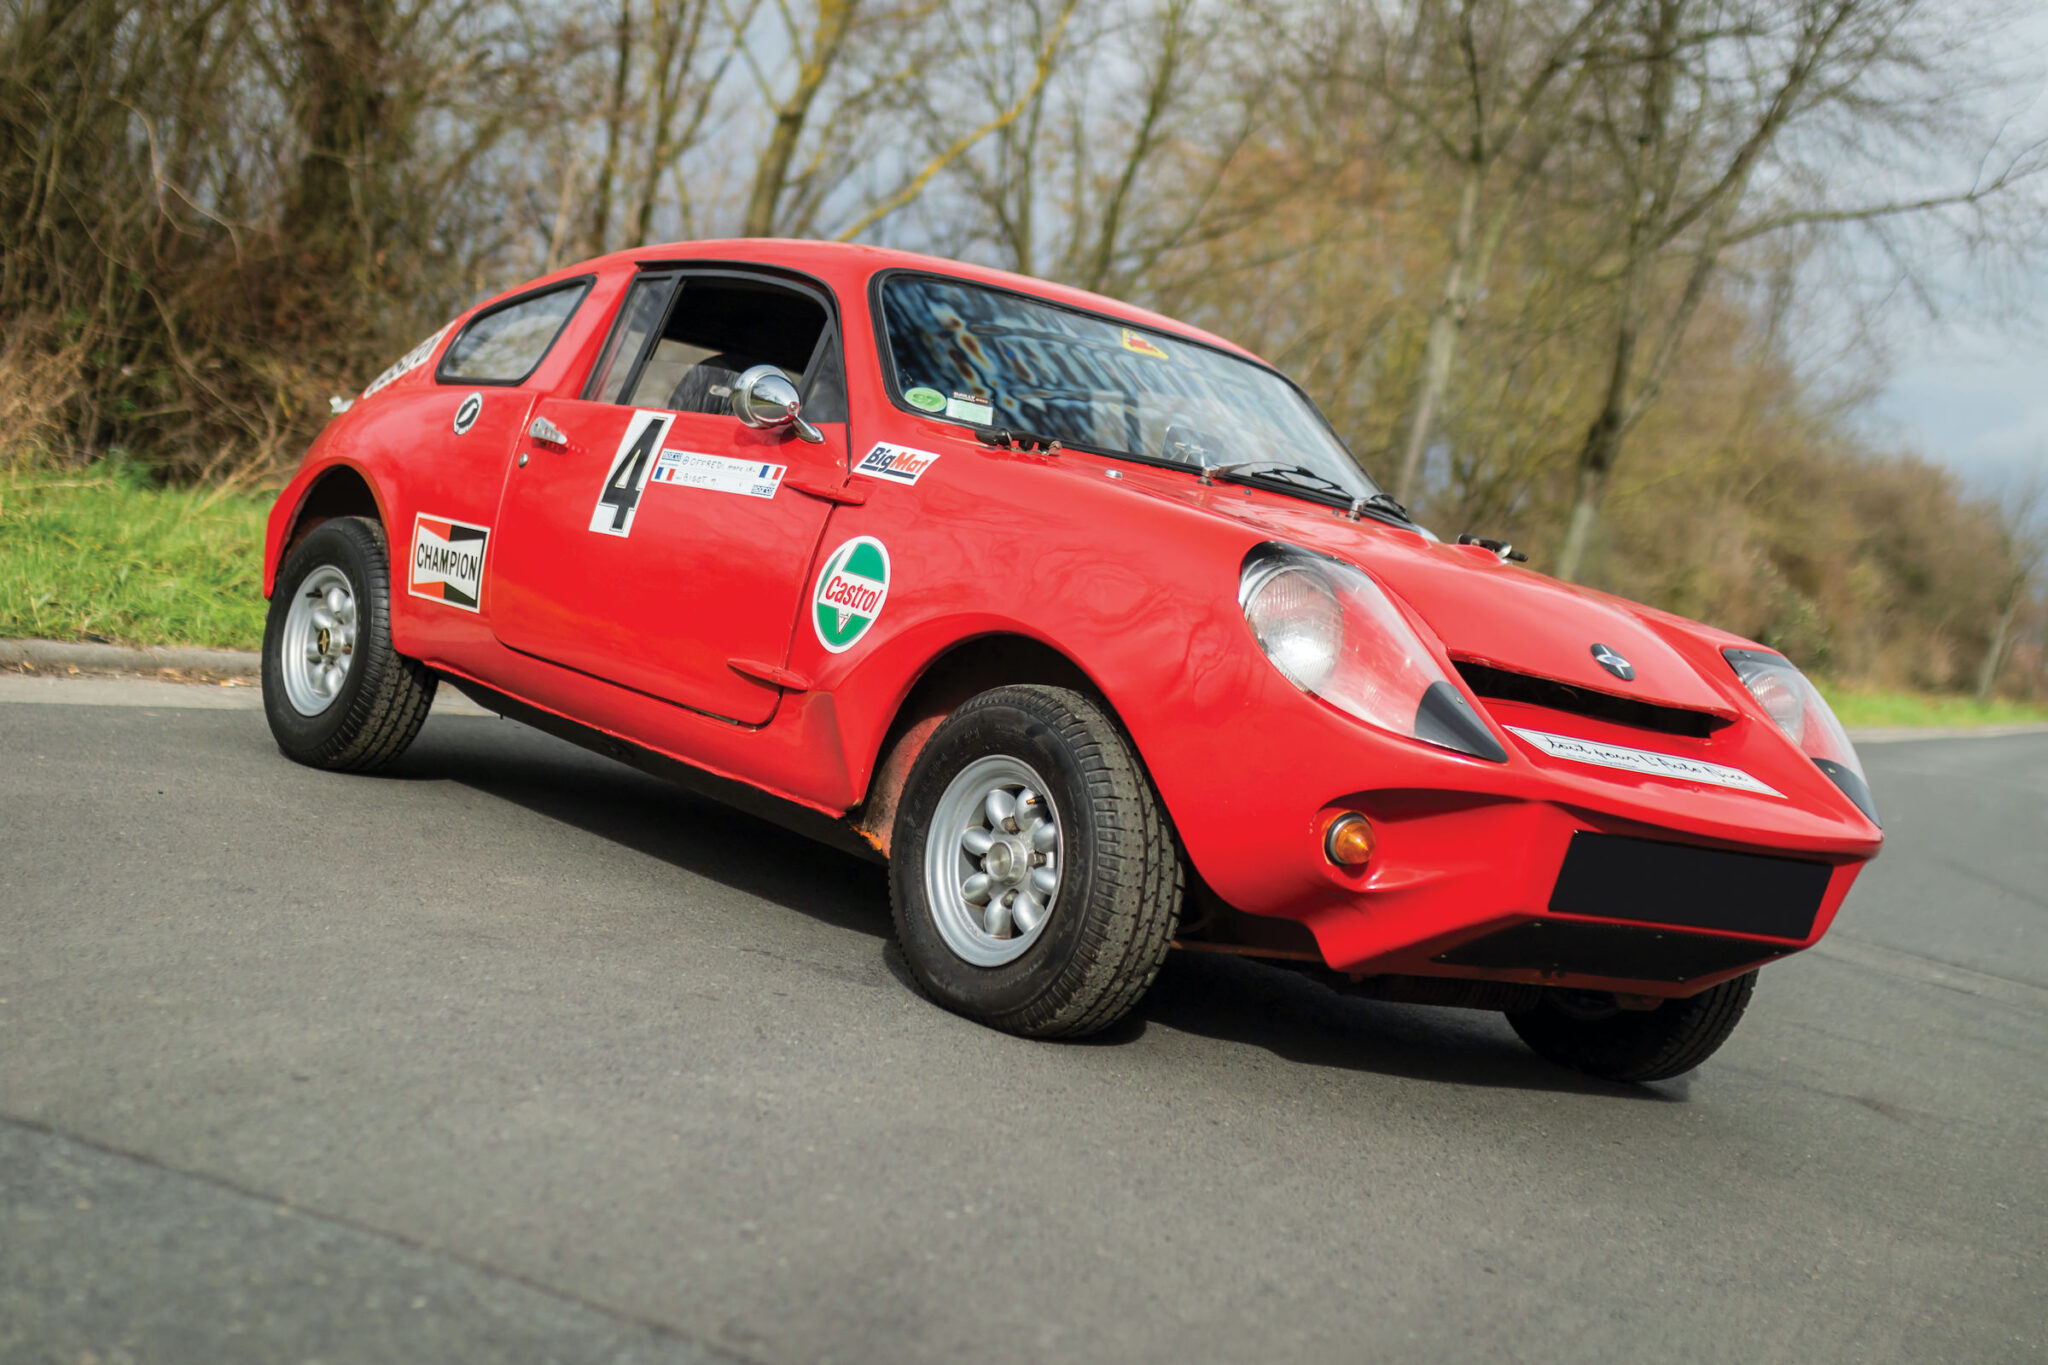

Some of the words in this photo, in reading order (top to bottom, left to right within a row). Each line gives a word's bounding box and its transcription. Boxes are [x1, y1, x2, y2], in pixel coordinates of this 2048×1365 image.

[600, 417, 668, 533] 4
[865, 446, 930, 474] BigMat
[417, 543, 478, 581] CHAMPION
[825, 575, 883, 613] Castrol
